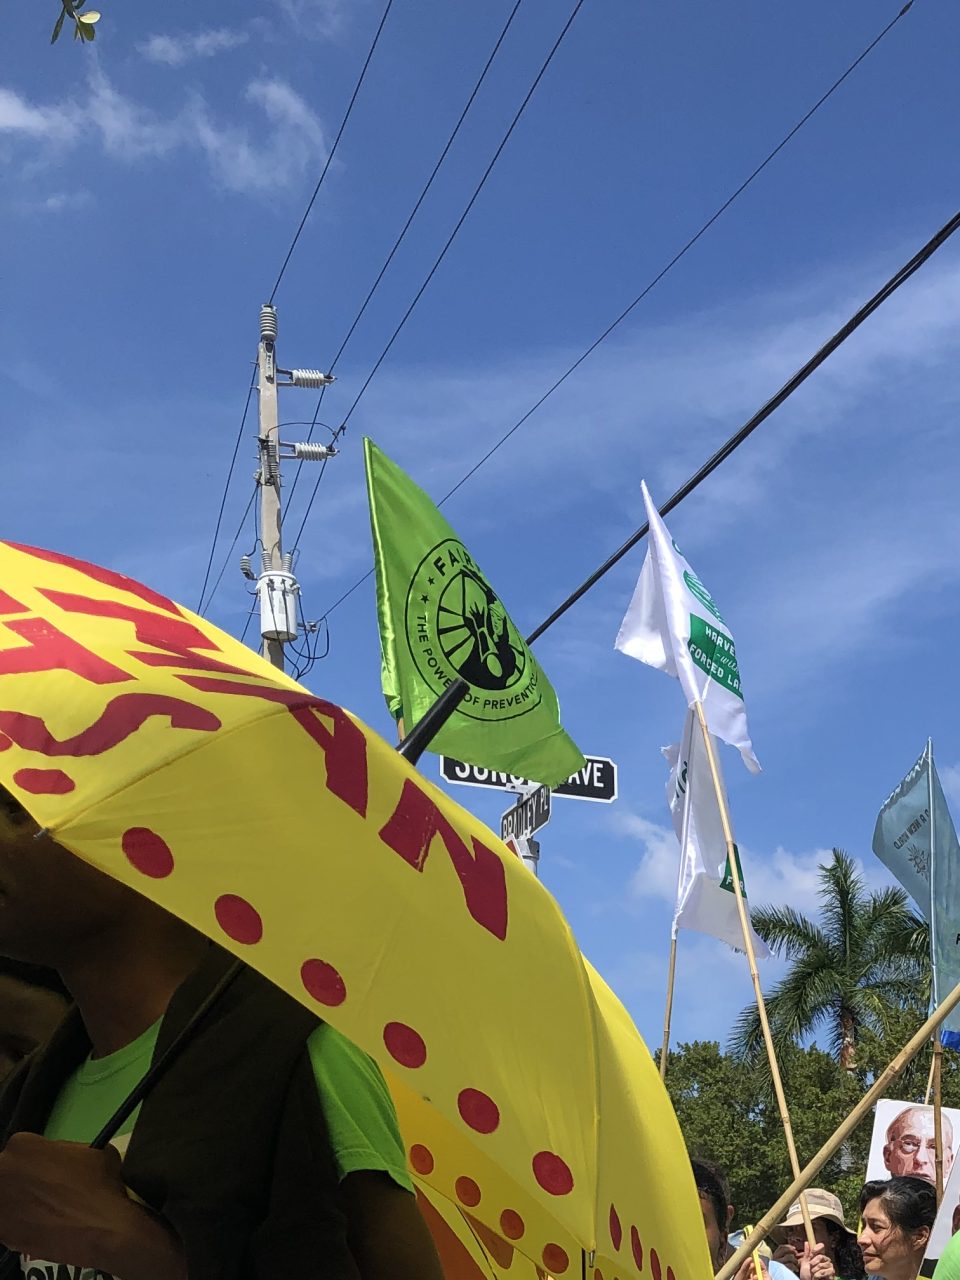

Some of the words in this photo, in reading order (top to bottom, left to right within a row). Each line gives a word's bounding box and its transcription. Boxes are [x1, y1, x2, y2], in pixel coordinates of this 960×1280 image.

[416, 615, 429, 643] THE
[422, 649, 453, 689] POWE
[689, 643, 724, 679] FORCED
[463, 692, 480, 706] OF
[568, 762, 604, 788] AVE
[502, 798, 538, 841] BRADLEY
[540, 788, 549, 813] PL
